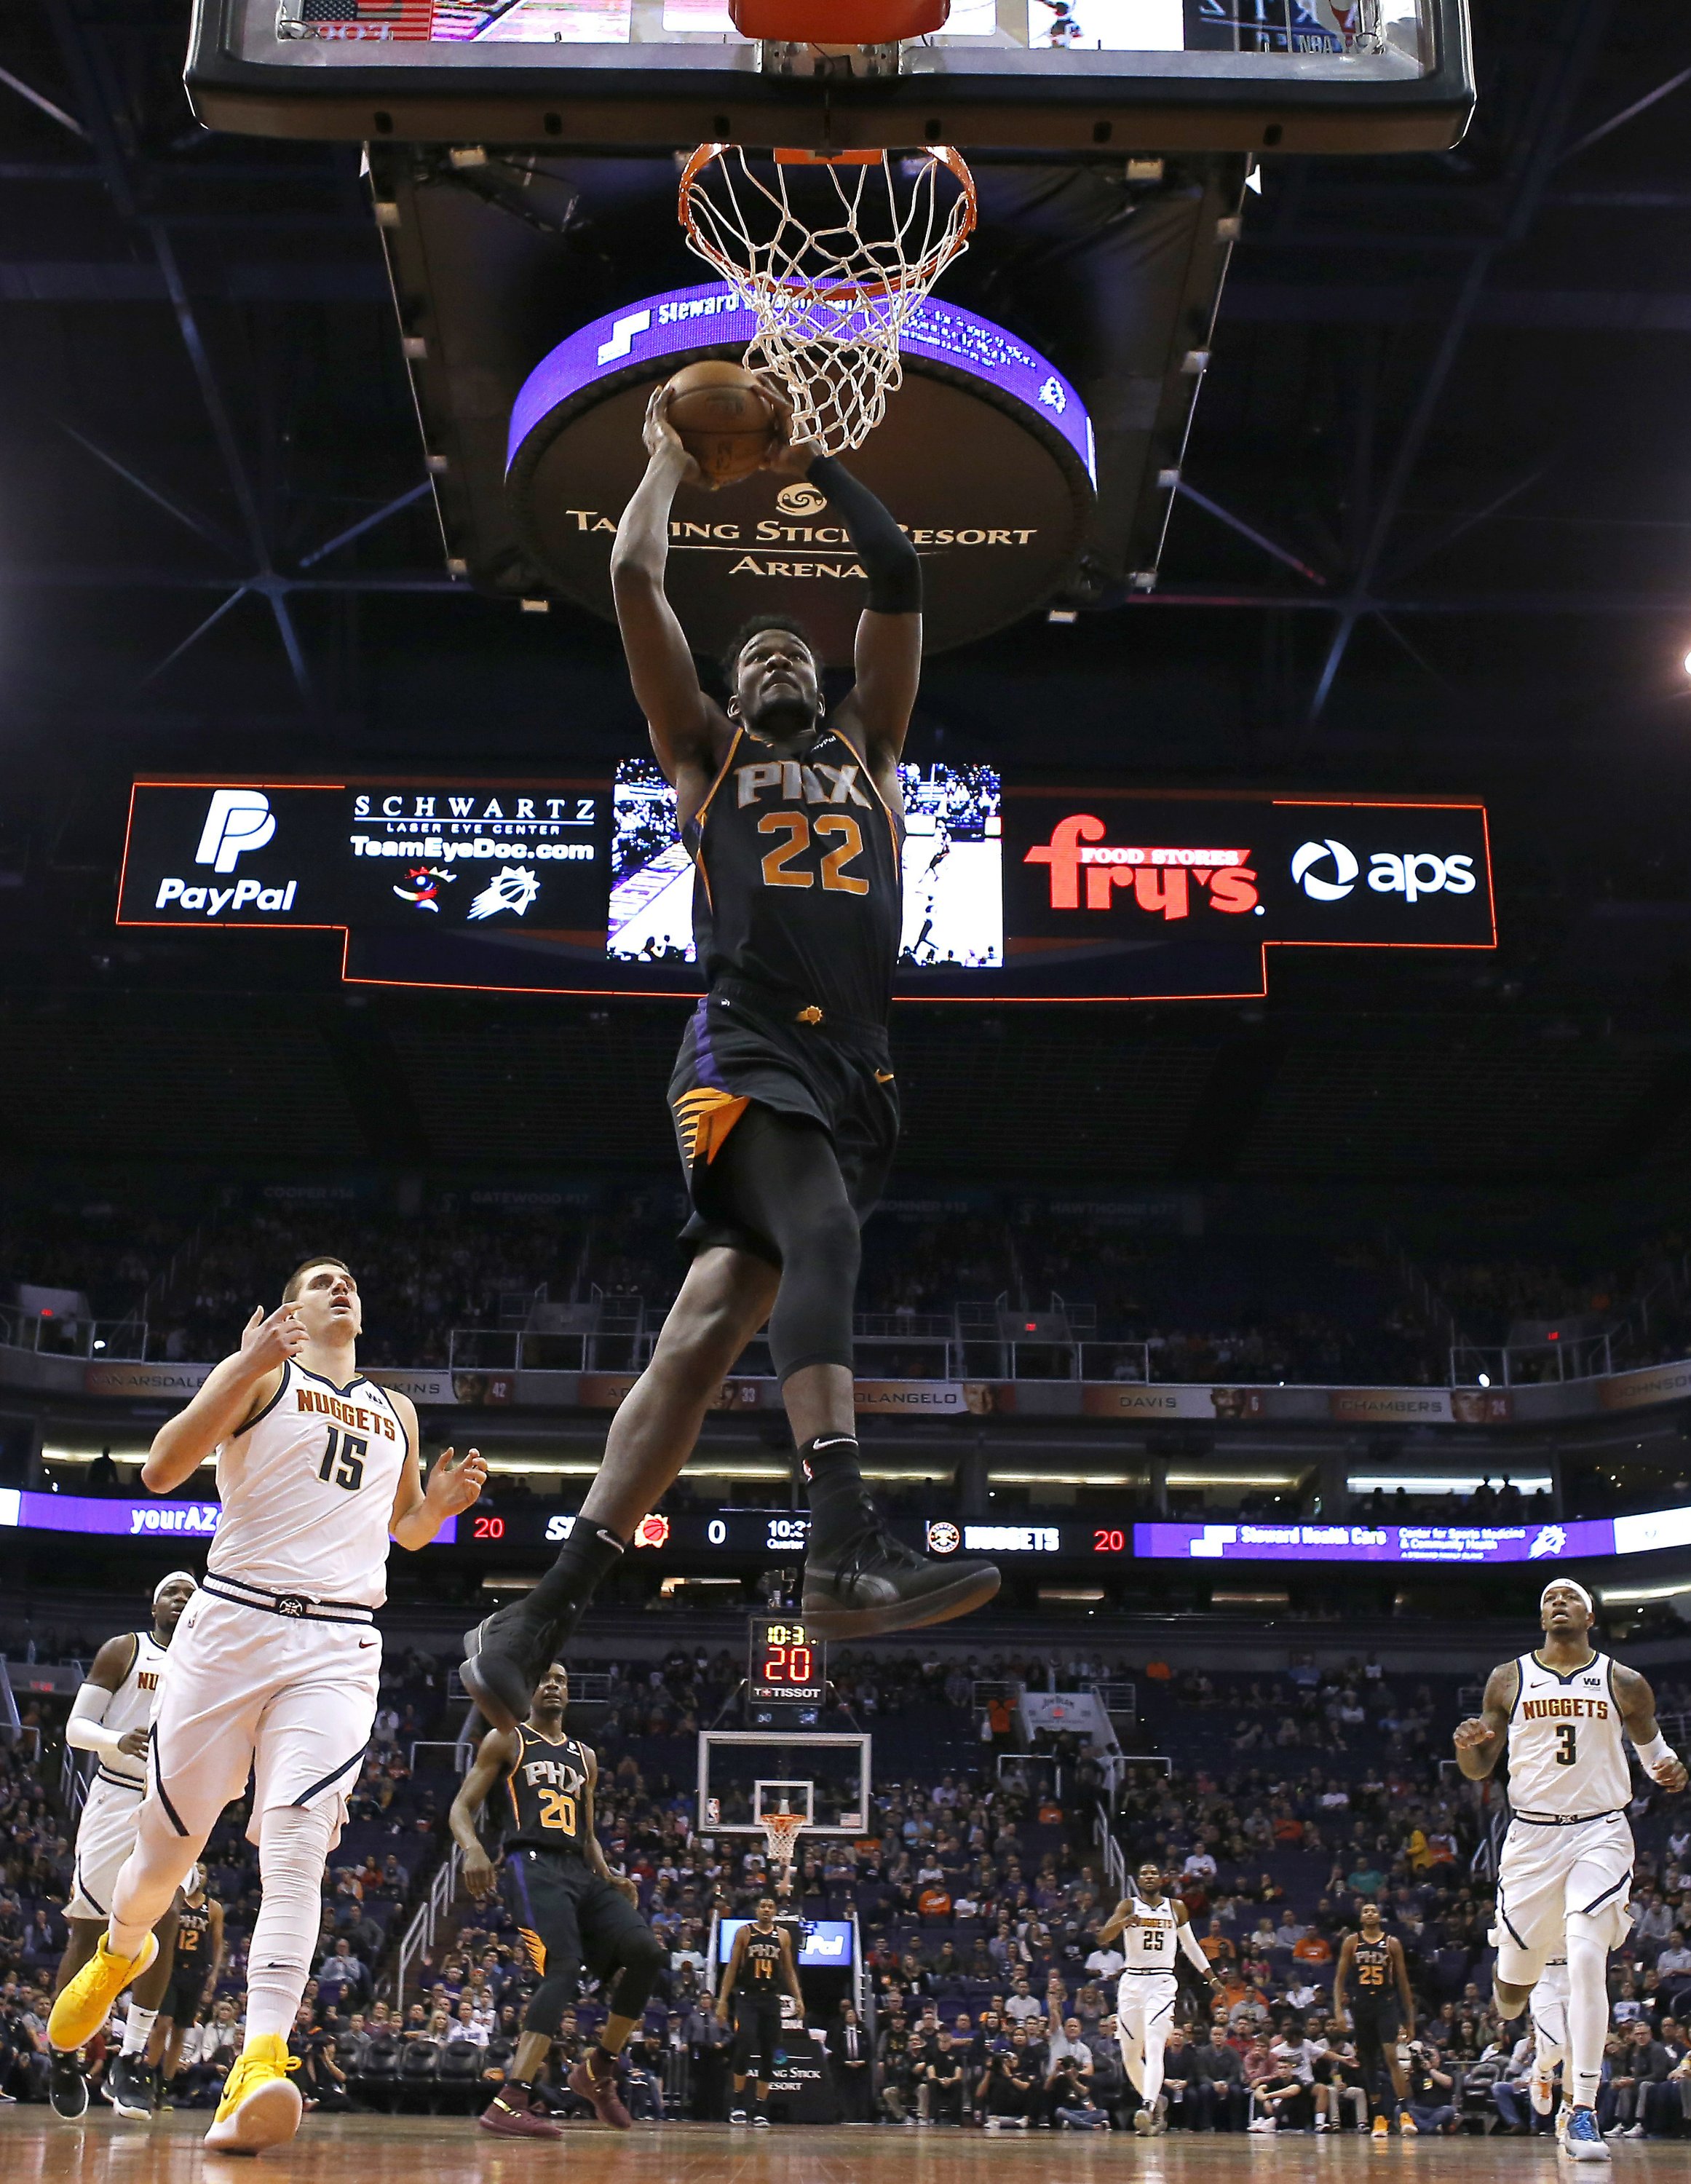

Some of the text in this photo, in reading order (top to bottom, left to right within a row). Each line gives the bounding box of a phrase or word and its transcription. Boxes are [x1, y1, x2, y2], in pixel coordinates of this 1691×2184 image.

[566, 510, 740, 539] TAING
[729, 555, 868, 578] ARENA
[811, 735, 836, 752] ayPal
[354, 795, 595, 820] SCHWARTZ
[387, 823, 560, 835] LASER EYE CENTER
[350, 835, 594, 862] TeamEyeDoc.com
[758, 811, 869, 895] 22
[1081, 847, 1239, 866] FOOD STORES
[1368, 853, 1476, 902] aps
[155, 878, 298, 916] PayPal
[471, 1190, 561, 1204] GATEWOOD
[381, 1382, 507, 1398] KINS 42
[854, 1393, 957, 1404] OLANGELO
[1120, 1396, 1176, 1409] DAVIS
[1342, 1401, 1442, 1413] CHAMBERS
[296, 1389, 395, 1441] NUGGETS
[319, 1425, 369, 1491] 15
[130, 1506, 222, 1534] yourAZ
[474, 1517, 504, 1538] 20
[708, 1520, 726, 1544] 0
[964, 1526, 1124, 1551] NUGGETS 20
[767, 1625, 805, 1646] 10:3
[765, 1647, 809, 1681] 20
[772, 1688, 821, 1698] TISSOT
[1523, 1698, 1608, 1720] NUGGETS
[1556, 1724, 1576, 1765] 3
[522, 1760, 587, 1800] PHX
[538, 1788, 577, 1837] 20
[178, 1929, 199, 1951] 12
[805, 1935, 844, 1955] Pal
[1144, 1931, 1164, 1950] 25
[748, 1944, 781, 1960] PHX
[754, 1959, 772, 1979] 14
[1358, 1965, 1385, 1985] 25
[790, 2067, 821, 2078] STICK
[769, 2082, 803, 2091] ESORT
